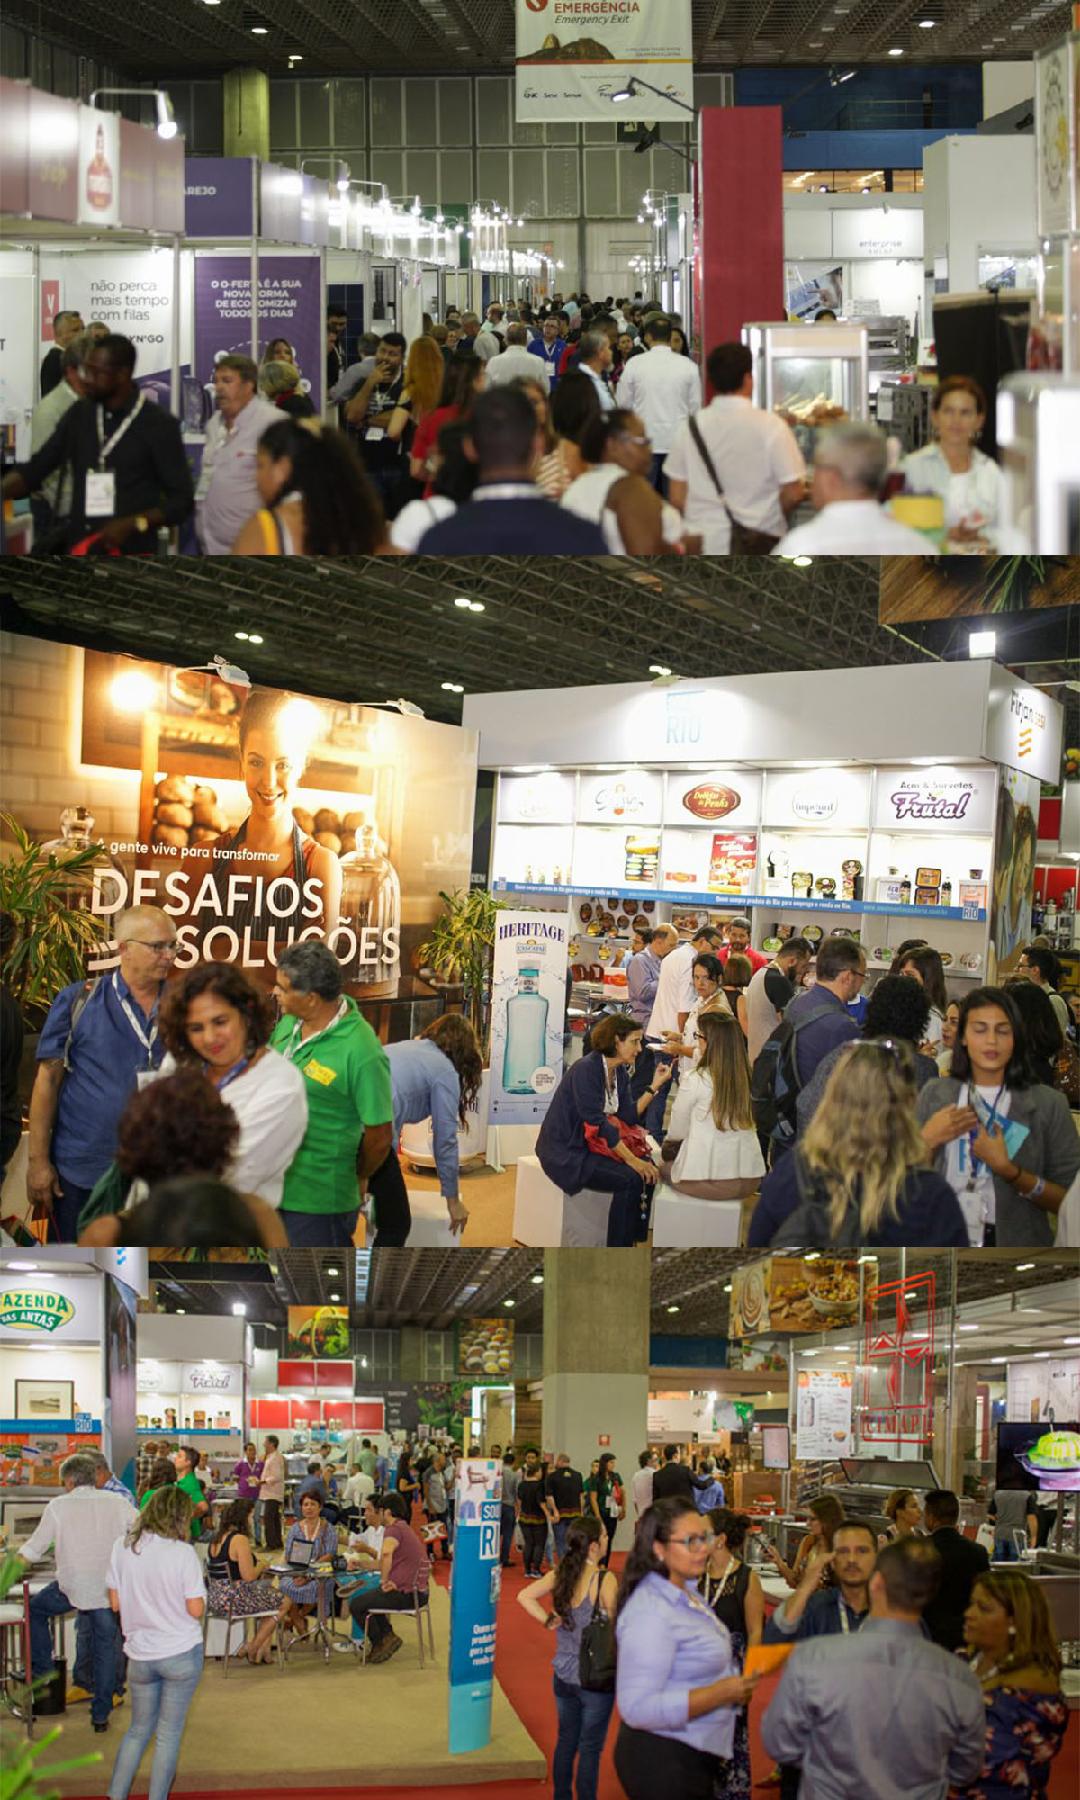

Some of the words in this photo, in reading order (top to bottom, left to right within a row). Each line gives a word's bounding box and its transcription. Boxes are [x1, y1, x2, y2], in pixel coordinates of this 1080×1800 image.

[554, 14, 609, 26] Emergency
[610, 14, 631, 24] Exit
[90, 280, 115, 292] não
[119, 281, 157, 293] perca
[281, 280, 302, 288] SUA
[257, 290, 290, 298] ORMA
[90, 295, 122, 306] mais
[125, 295, 169, 307] tempo
[230, 299, 297, 308] ECOOMIZAR
[90, 310, 121, 321] com
[124, 309, 150, 321] filas
[270, 309, 294, 318] DIAS
[891, 791, 972, 820] Frutal
[110, 841, 149, 855] gente
[151, 841, 177, 856] vive
[180, 845, 210, 860] para
[212, 846, 281, 863] transformar
[91, 868, 325, 919] DESAFIOS
[499, 922, 565, 943] HERITAGE
[2, 1293, 69, 1313] AZENDA
[20, 1311, 56, 1329] ANTAS
